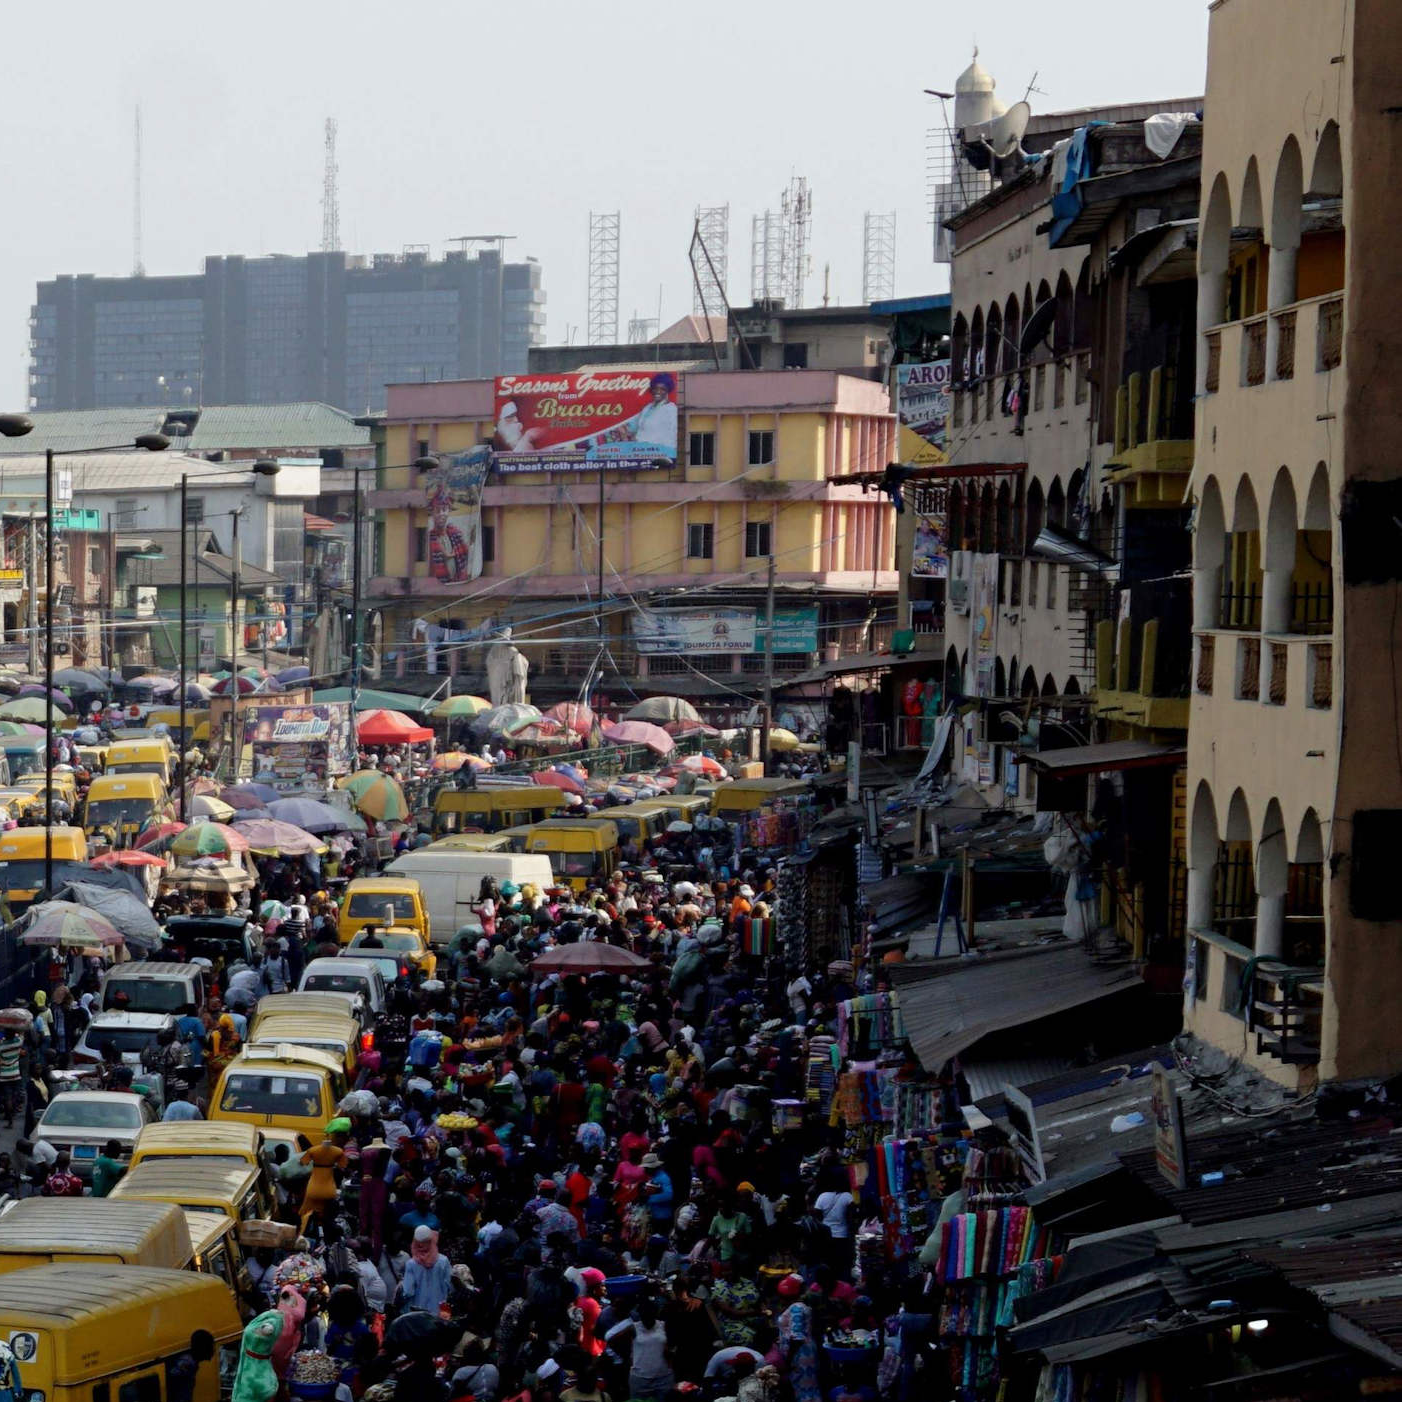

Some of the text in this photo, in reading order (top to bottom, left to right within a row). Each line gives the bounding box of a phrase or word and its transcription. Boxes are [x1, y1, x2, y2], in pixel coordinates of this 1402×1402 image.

[498, 373, 651, 397] Seasons Greeting
[534, 398, 623, 418] Brasas
[518, 462, 542, 472] best
[544, 461, 571, 470] cloth
[573, 460, 603, 470] seller
[607, 460, 617, 468] in
[619, 460, 638, 468] the
